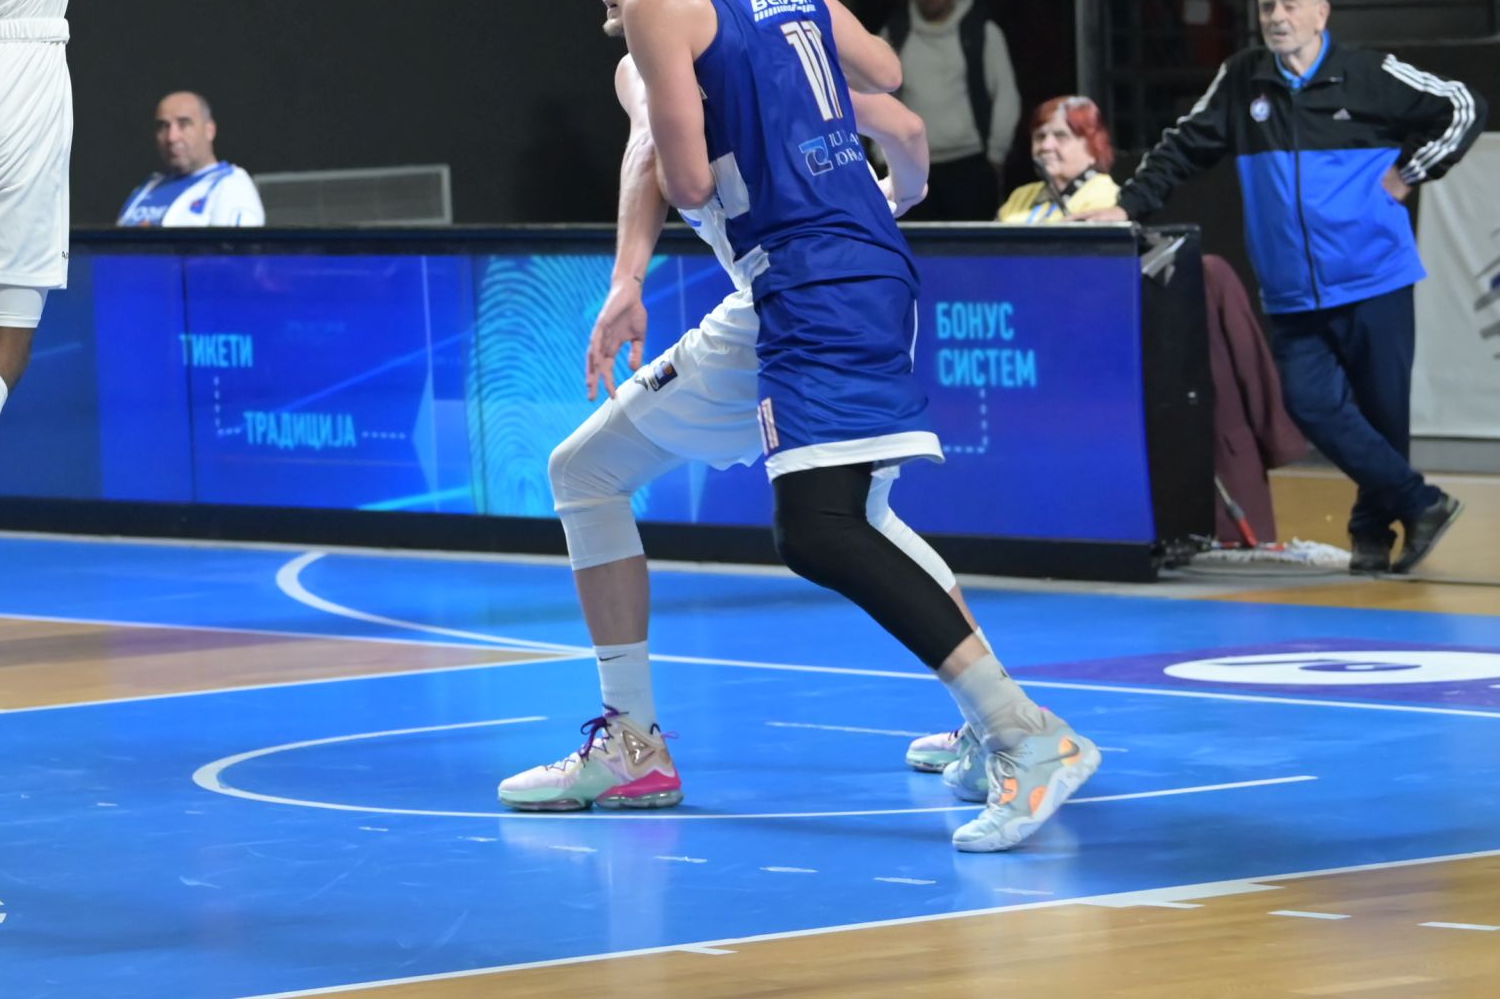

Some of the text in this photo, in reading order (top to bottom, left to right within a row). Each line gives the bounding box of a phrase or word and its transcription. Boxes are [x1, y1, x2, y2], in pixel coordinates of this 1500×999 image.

[780, 20, 843, 122] 11
[935, 301, 1015, 341] БОНУС
[179, 333, 254, 369] ТИКЕТИ
[937, 347, 1039, 389] СИСТЕМ
[242, 410, 358, 451] ТРАДИЦИЈА
